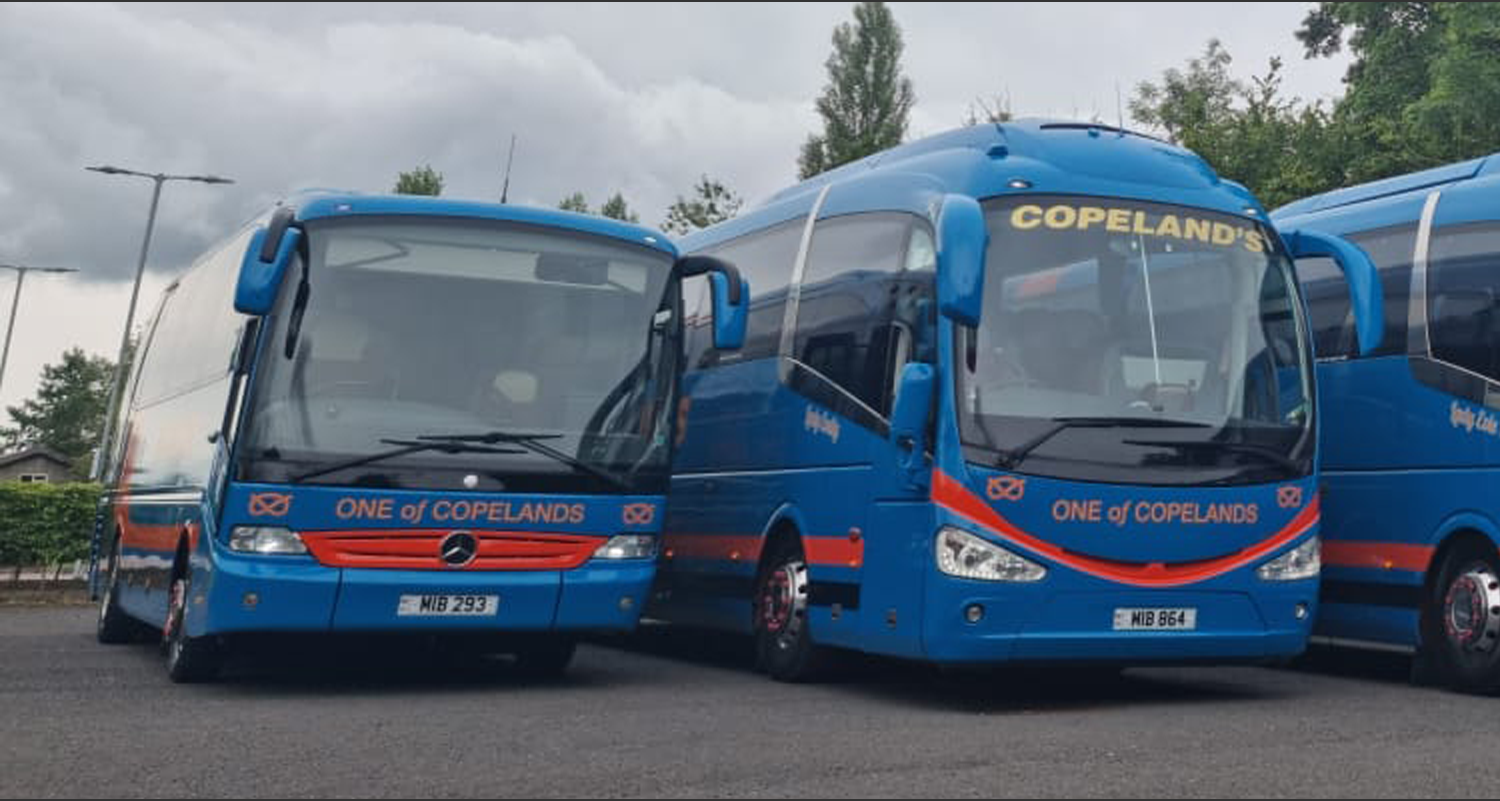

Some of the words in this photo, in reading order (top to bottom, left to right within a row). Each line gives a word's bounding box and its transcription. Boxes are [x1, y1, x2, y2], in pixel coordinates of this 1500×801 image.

[1010, 204, 1264, 252] COPELAND'S
[336, 498, 393, 519] ONE
[401, 501, 427, 523] of
[432, 500, 585, 524] COPELANDS
[1052, 500, 1102, 521] ONE
[1108, 501, 1131, 526] of
[1135, 502, 1258, 524] COPELANDS
[420, 595, 448, 612] MIB
[452, 595, 487, 612] 293
[1131, 611, 1155, 627] MIB
[1158, 611, 1186, 627] 864
